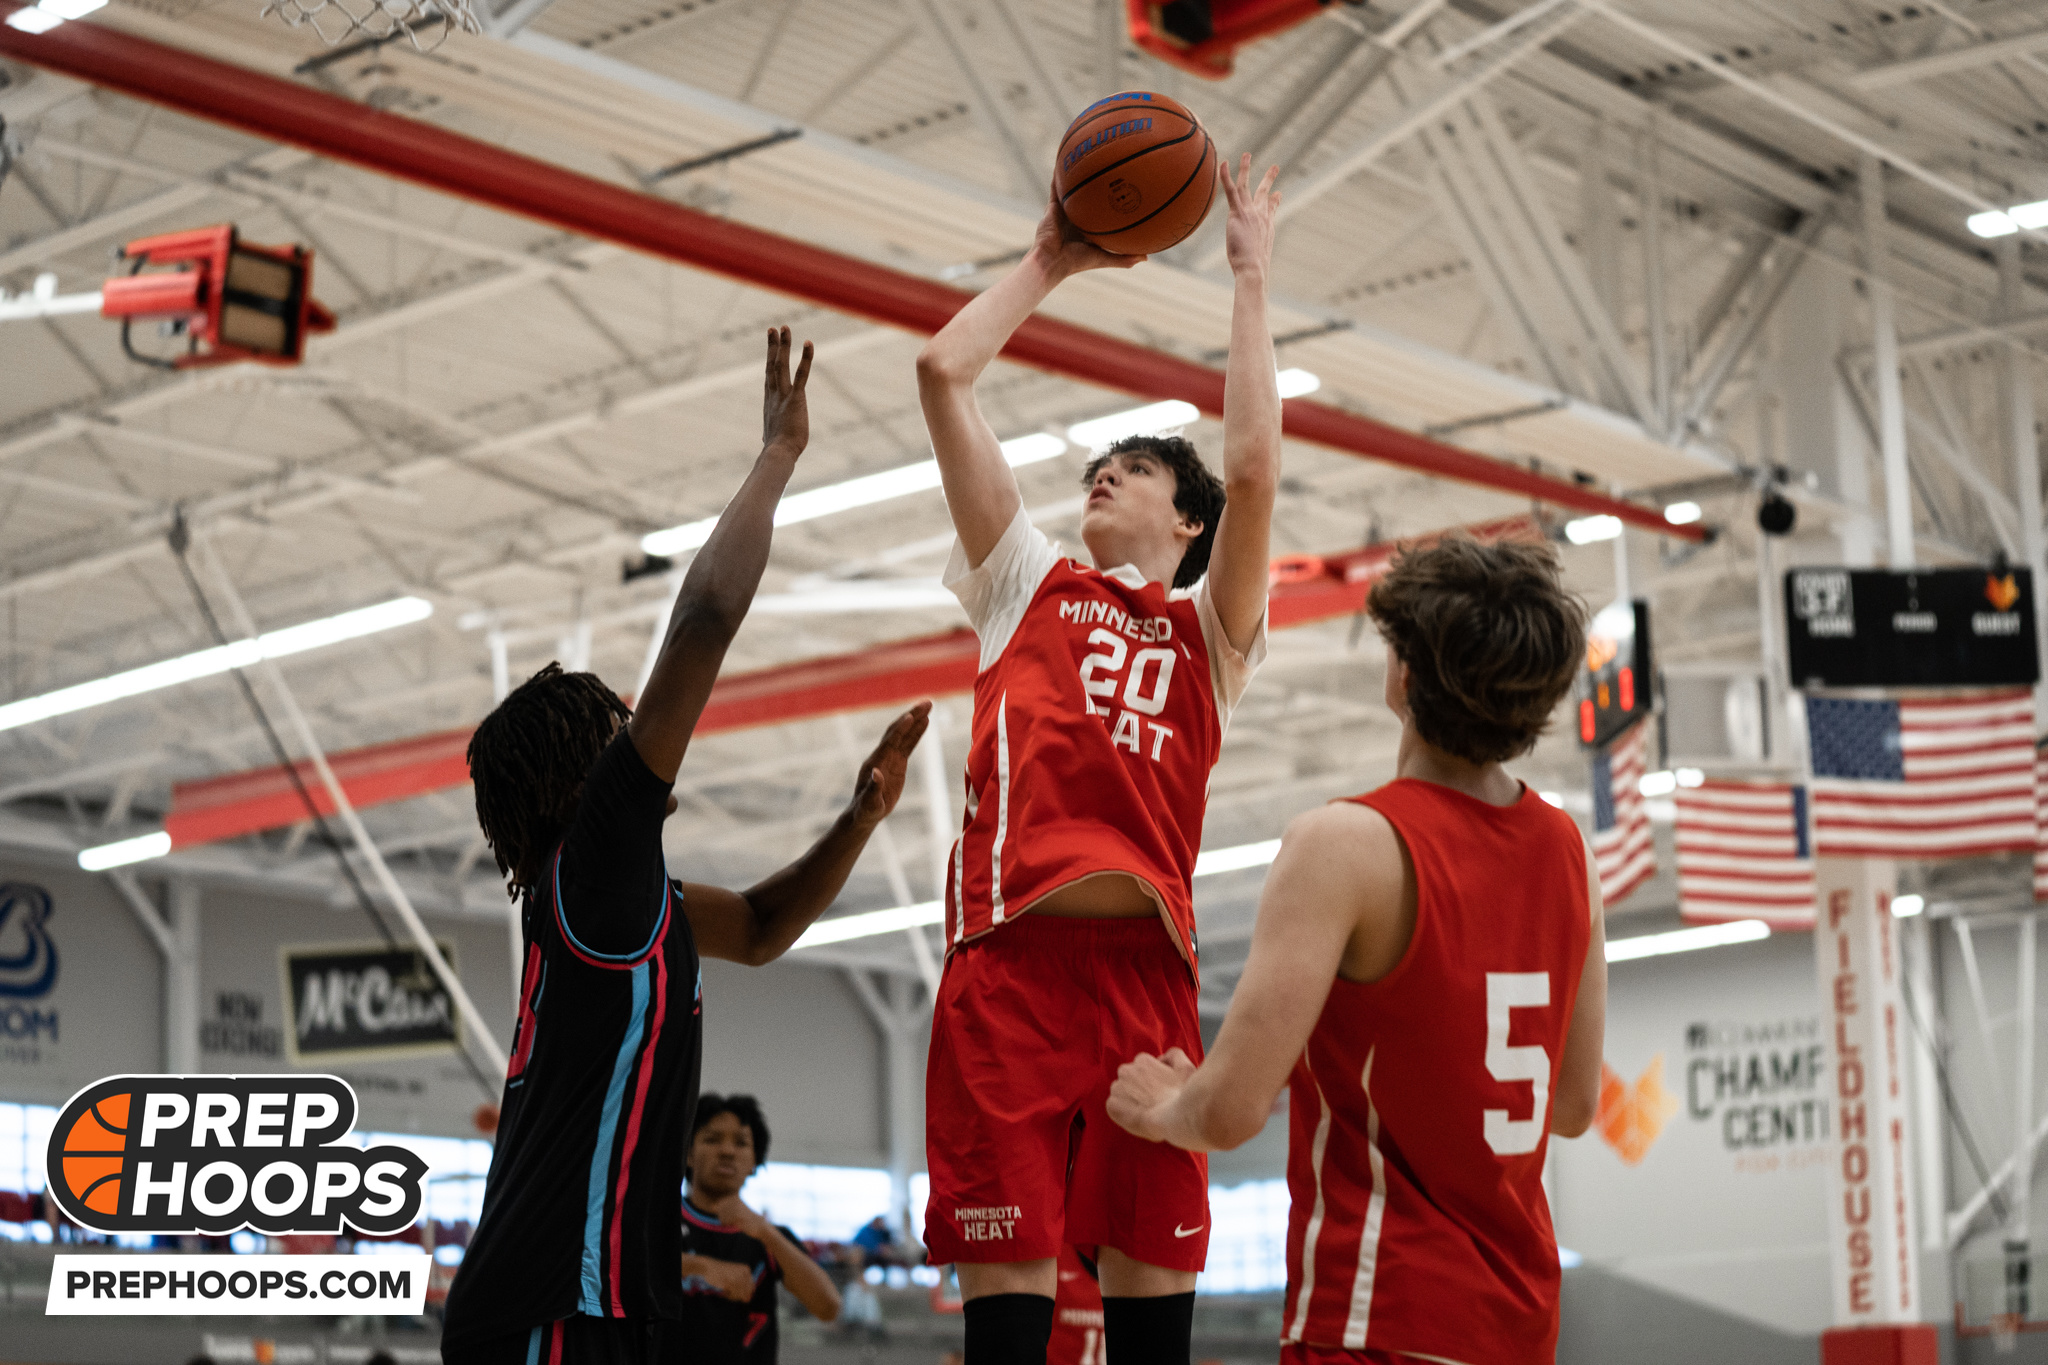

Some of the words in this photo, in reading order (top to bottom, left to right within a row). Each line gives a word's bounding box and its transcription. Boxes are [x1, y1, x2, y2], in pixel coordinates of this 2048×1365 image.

[1063, 118, 1152, 172] EVOLUTION
[1059, 600, 1191, 660] MINNESO
[1079, 628, 1177, 716] 20
[1086, 692, 1173, 762] AT
[0, 1005, 60, 1042] OM
[1484, 971, 1550, 1156] 5
[1829, 889, 1874, 1314] FIELDHOUSE
[954, 1205, 1023, 1222] MINNESOTA
[964, 1219, 1016, 1242] HEAT
[742, 1312, 769, 1348] 7
